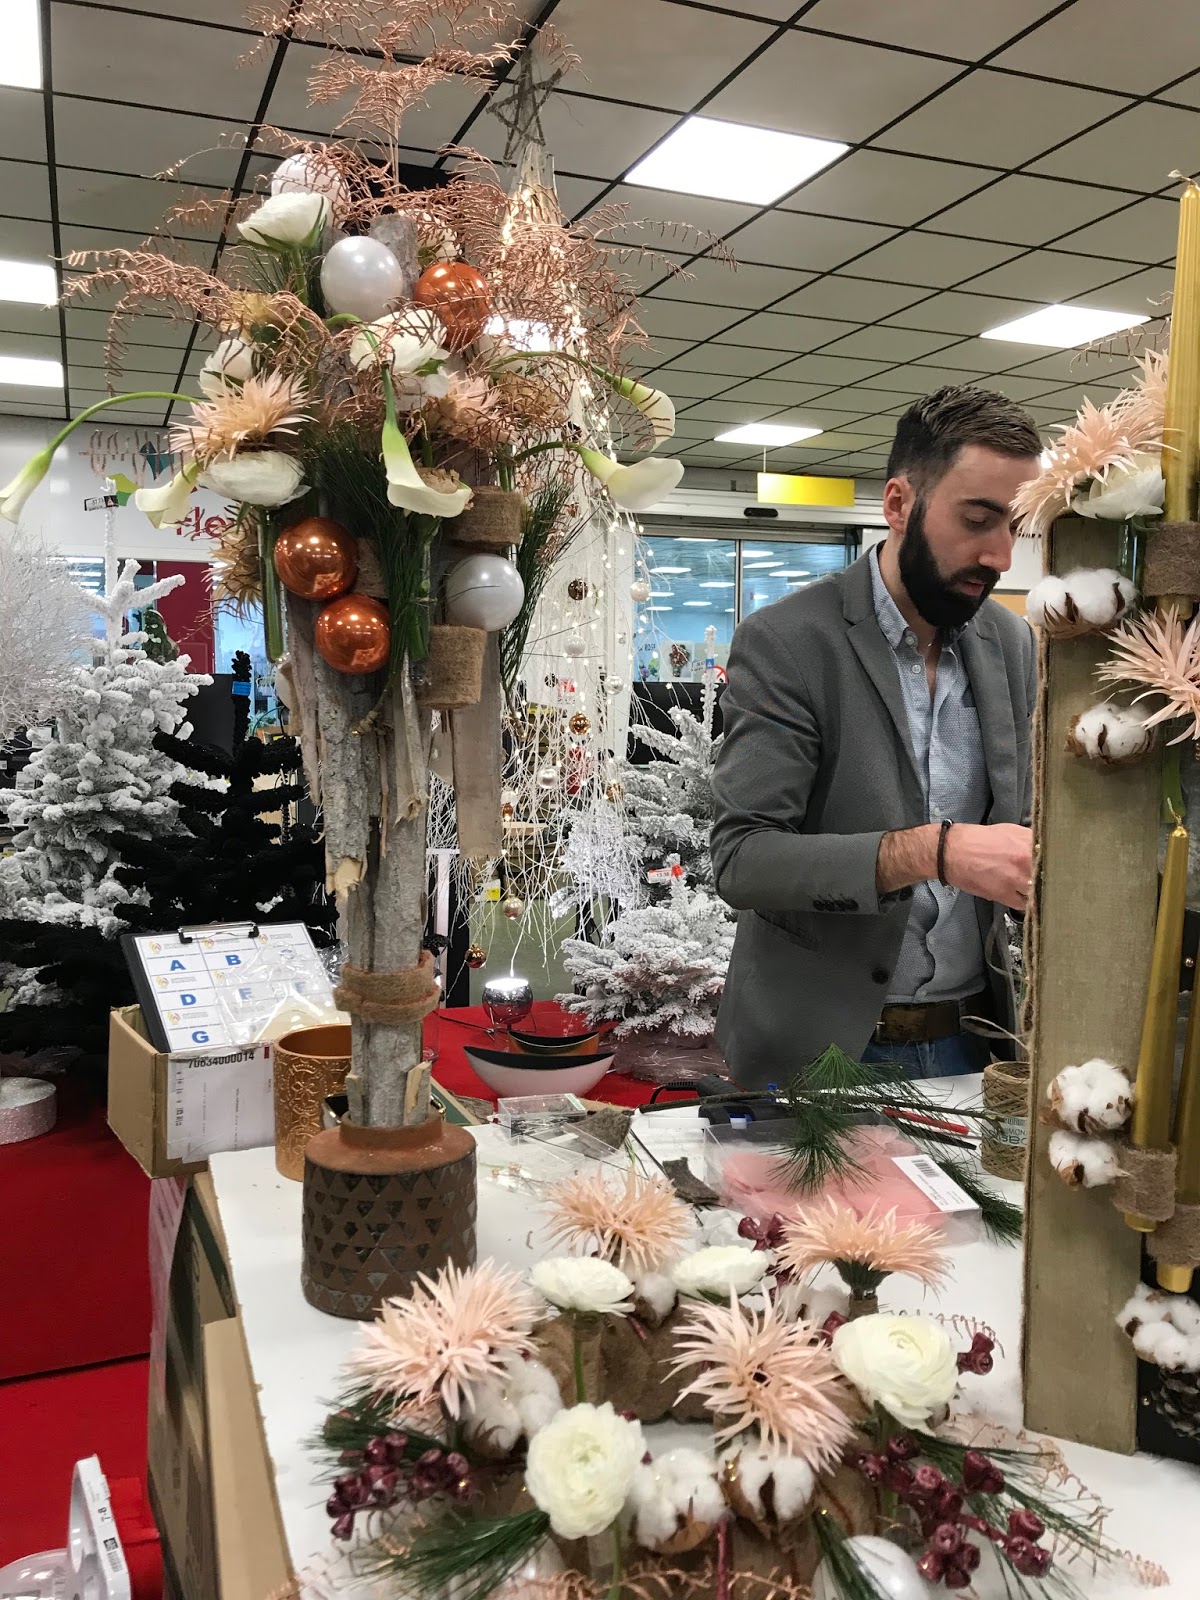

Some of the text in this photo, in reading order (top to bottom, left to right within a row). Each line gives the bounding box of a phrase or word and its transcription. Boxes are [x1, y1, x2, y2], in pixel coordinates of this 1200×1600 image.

[169, 959, 186, 972] A
[225, 954, 242, 966] B
[180, 993, 197, 1006] D
[191, 1030, 210, 1044] G
